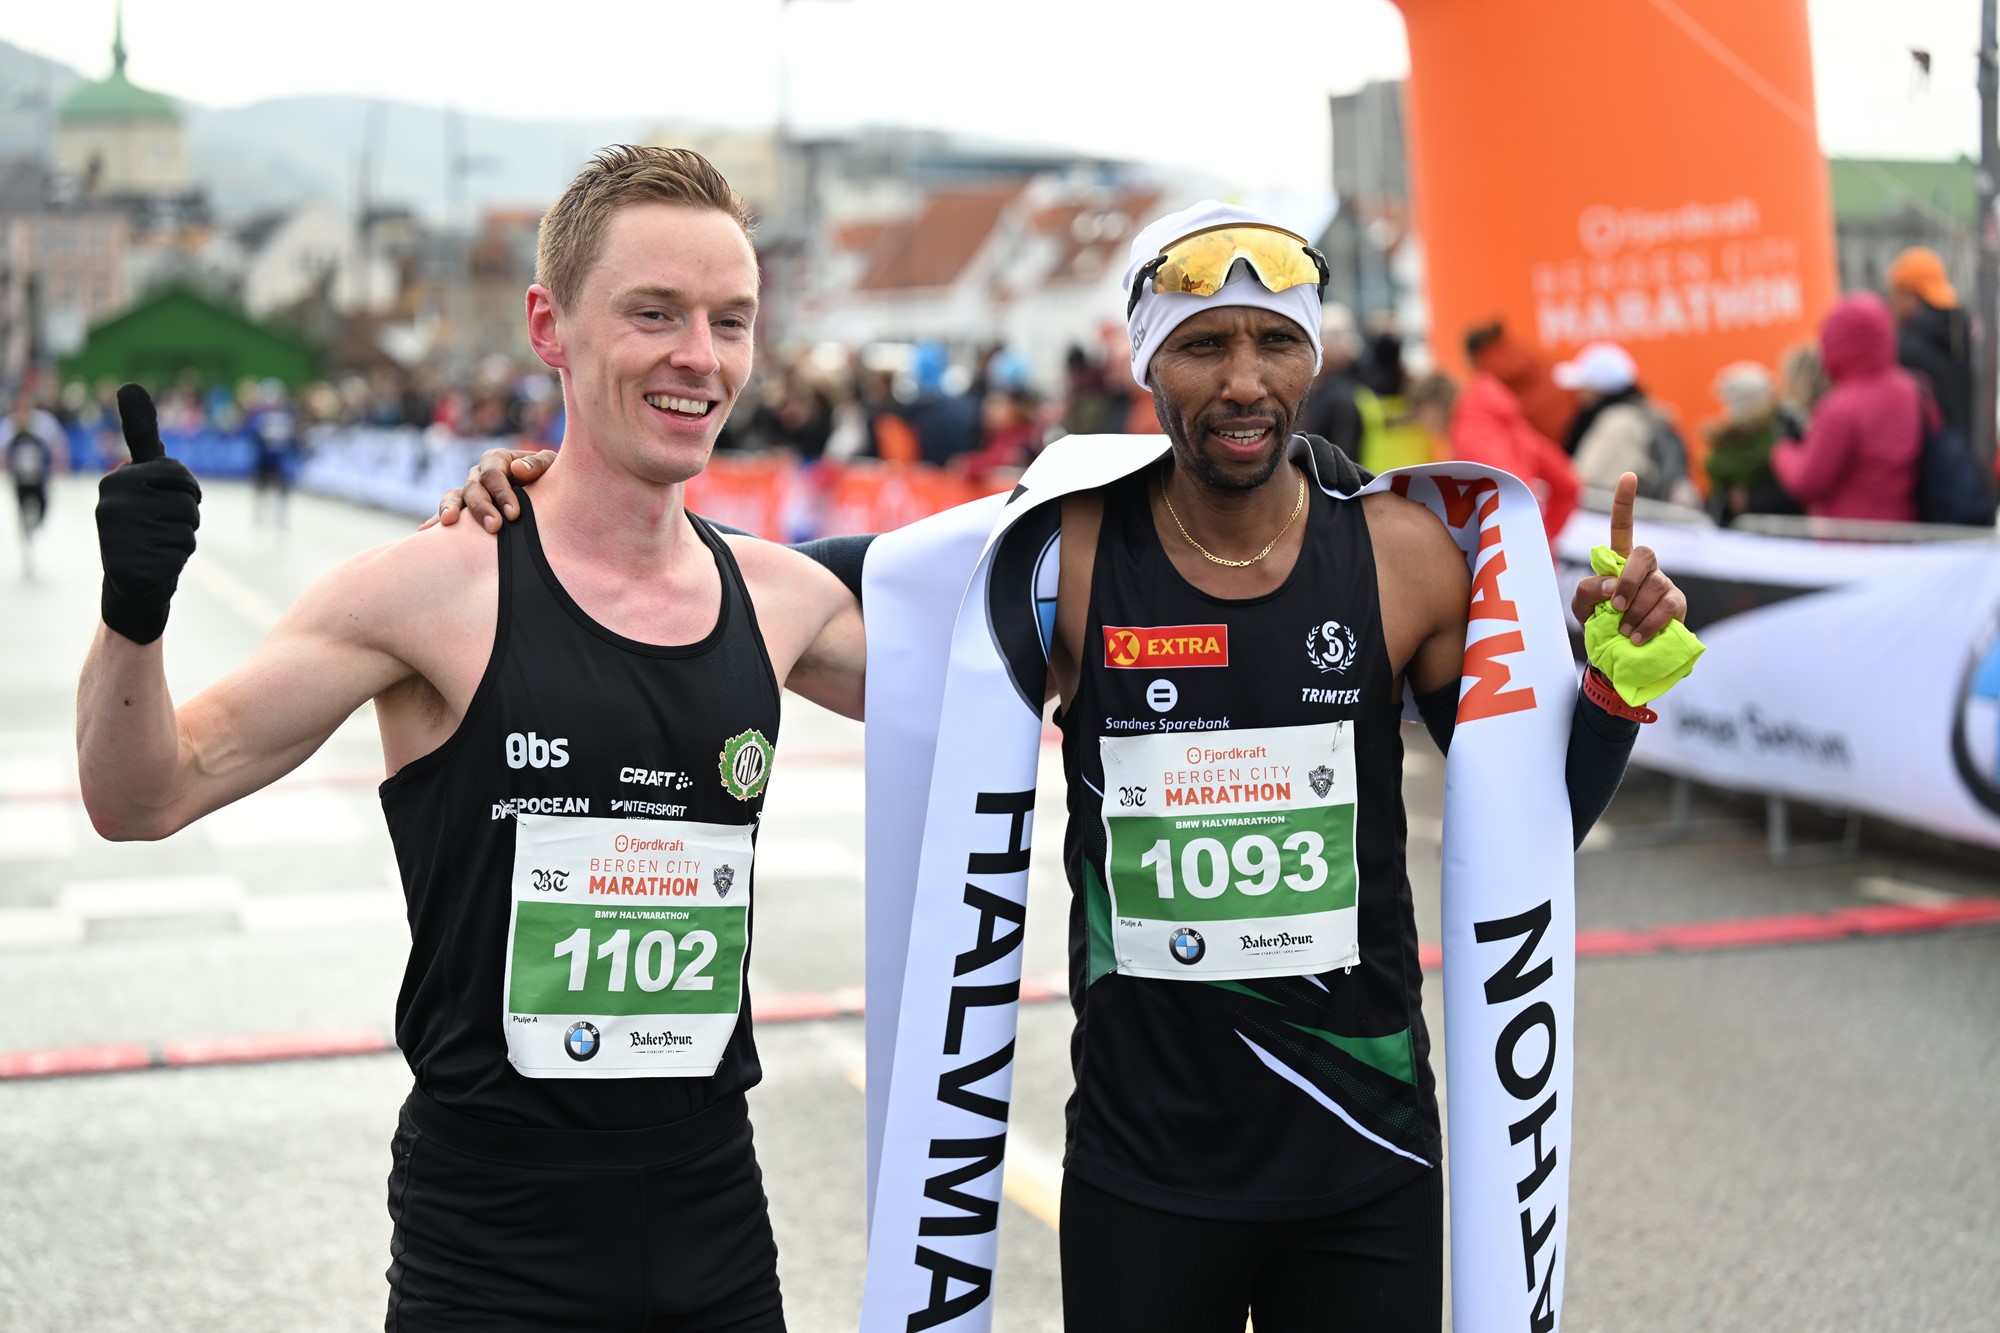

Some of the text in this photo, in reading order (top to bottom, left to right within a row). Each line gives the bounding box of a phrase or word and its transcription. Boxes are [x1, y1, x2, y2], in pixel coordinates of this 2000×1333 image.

[1536, 274, 1802, 348] MARATHON
[1147, 636, 1221, 656] EXTRA
[1301, 687, 1361, 705] TRIMTEX
[1105, 716, 1230, 733] Sandnes Sparebank
[1204, 746, 1267, 764] Fjordkraft
[619, 766, 677, 788] CRAFT
[1164, 767, 1240, 785] BERGEN
[1250, 765, 1292, 781] CITY
[1118, 785, 1148, 808] BT
[1165, 781, 1292, 807] MARATHON
[623, 799, 688, 818] INTERSPORT
[1175, 814, 1286, 830] BMW HALVMARATHON
[630, 838, 685, 853] Fjordkraft
[589, 857, 701, 874] BERGEN CITY
[1140, 830, 1329, 900] 1093
[530, 868, 570, 893] BT
[588, 875, 699, 897] MARATHON
[594, 910, 690, 920] BMW HALVMARATHON
[1120, 919, 1143, 928] Pulje A
[1239, 931, 1314, 951] BakerBrun
[553, 928, 718, 993] 1102
[512, 1015, 532, 1024] Pulje
[629, 1030, 693, 1048] BakerBrun
